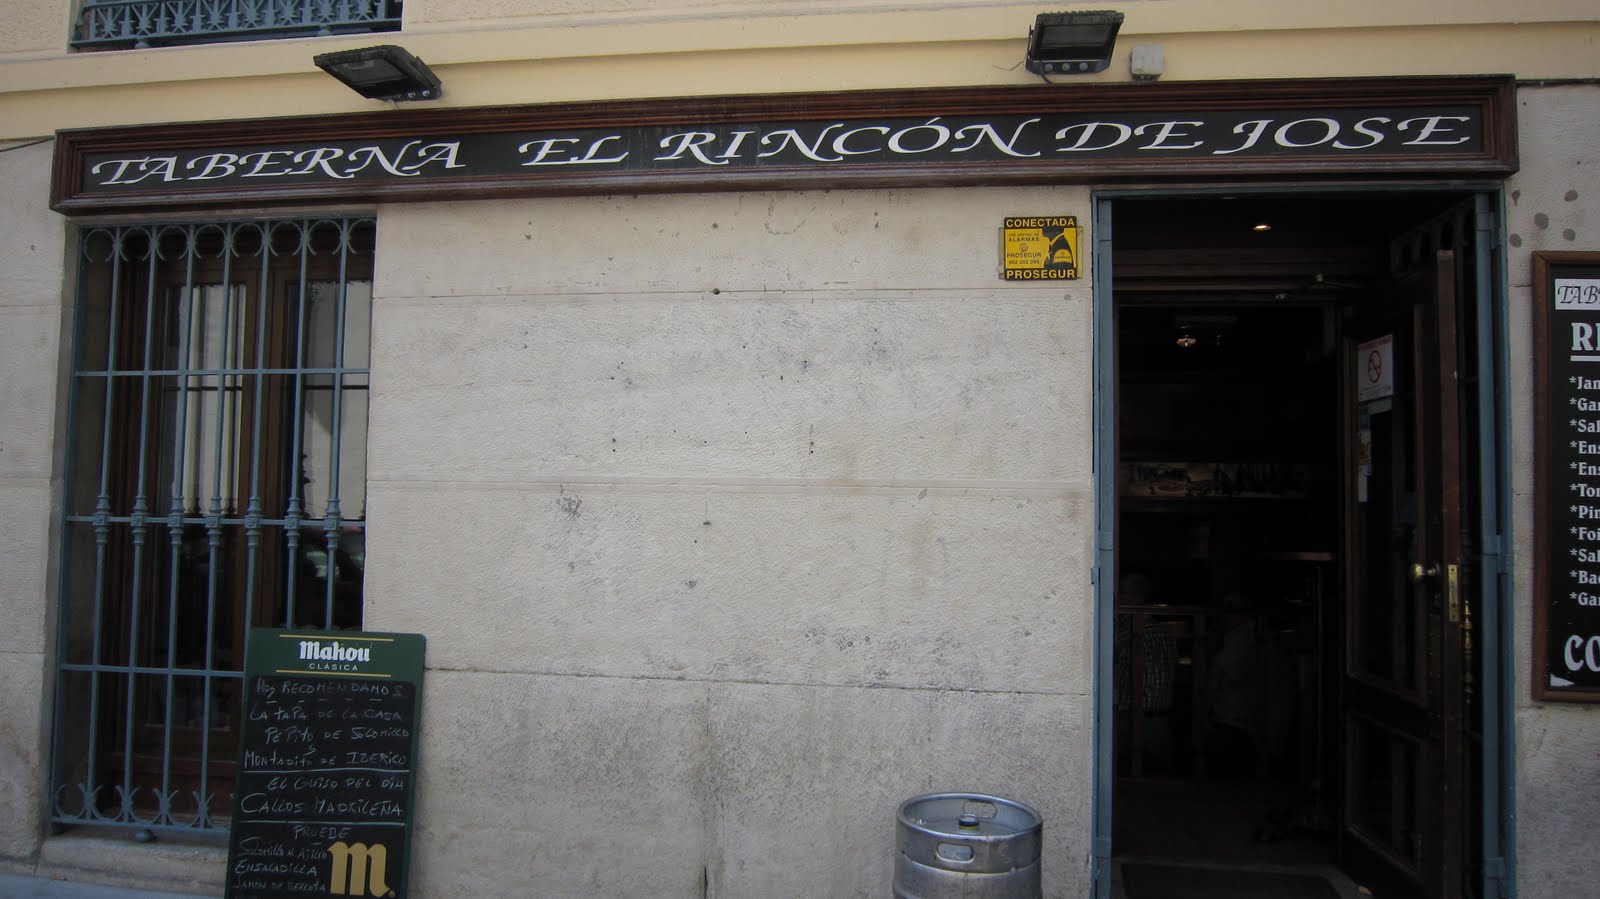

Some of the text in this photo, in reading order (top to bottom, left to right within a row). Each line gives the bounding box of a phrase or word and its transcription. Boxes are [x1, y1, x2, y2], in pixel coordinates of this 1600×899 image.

[92, 116, 1471, 185] TABERNA EL RINCÓN DE JOSE
[1006, 218, 1075, 227] CONECTADA
[1006, 270, 1075, 279] PROSEGUR
[1557, 285, 1600, 304] TAB
[1571, 322, 1600, 351] R
[299, 640, 371, 662] Mahou
[324, 729, 342, 740] DE
[268, 776, 286, 791] EL
[346, 777, 371, 789] DEL
[241, 792, 305, 814] CALLOS
[293, 824, 351, 840] PRUEBE
